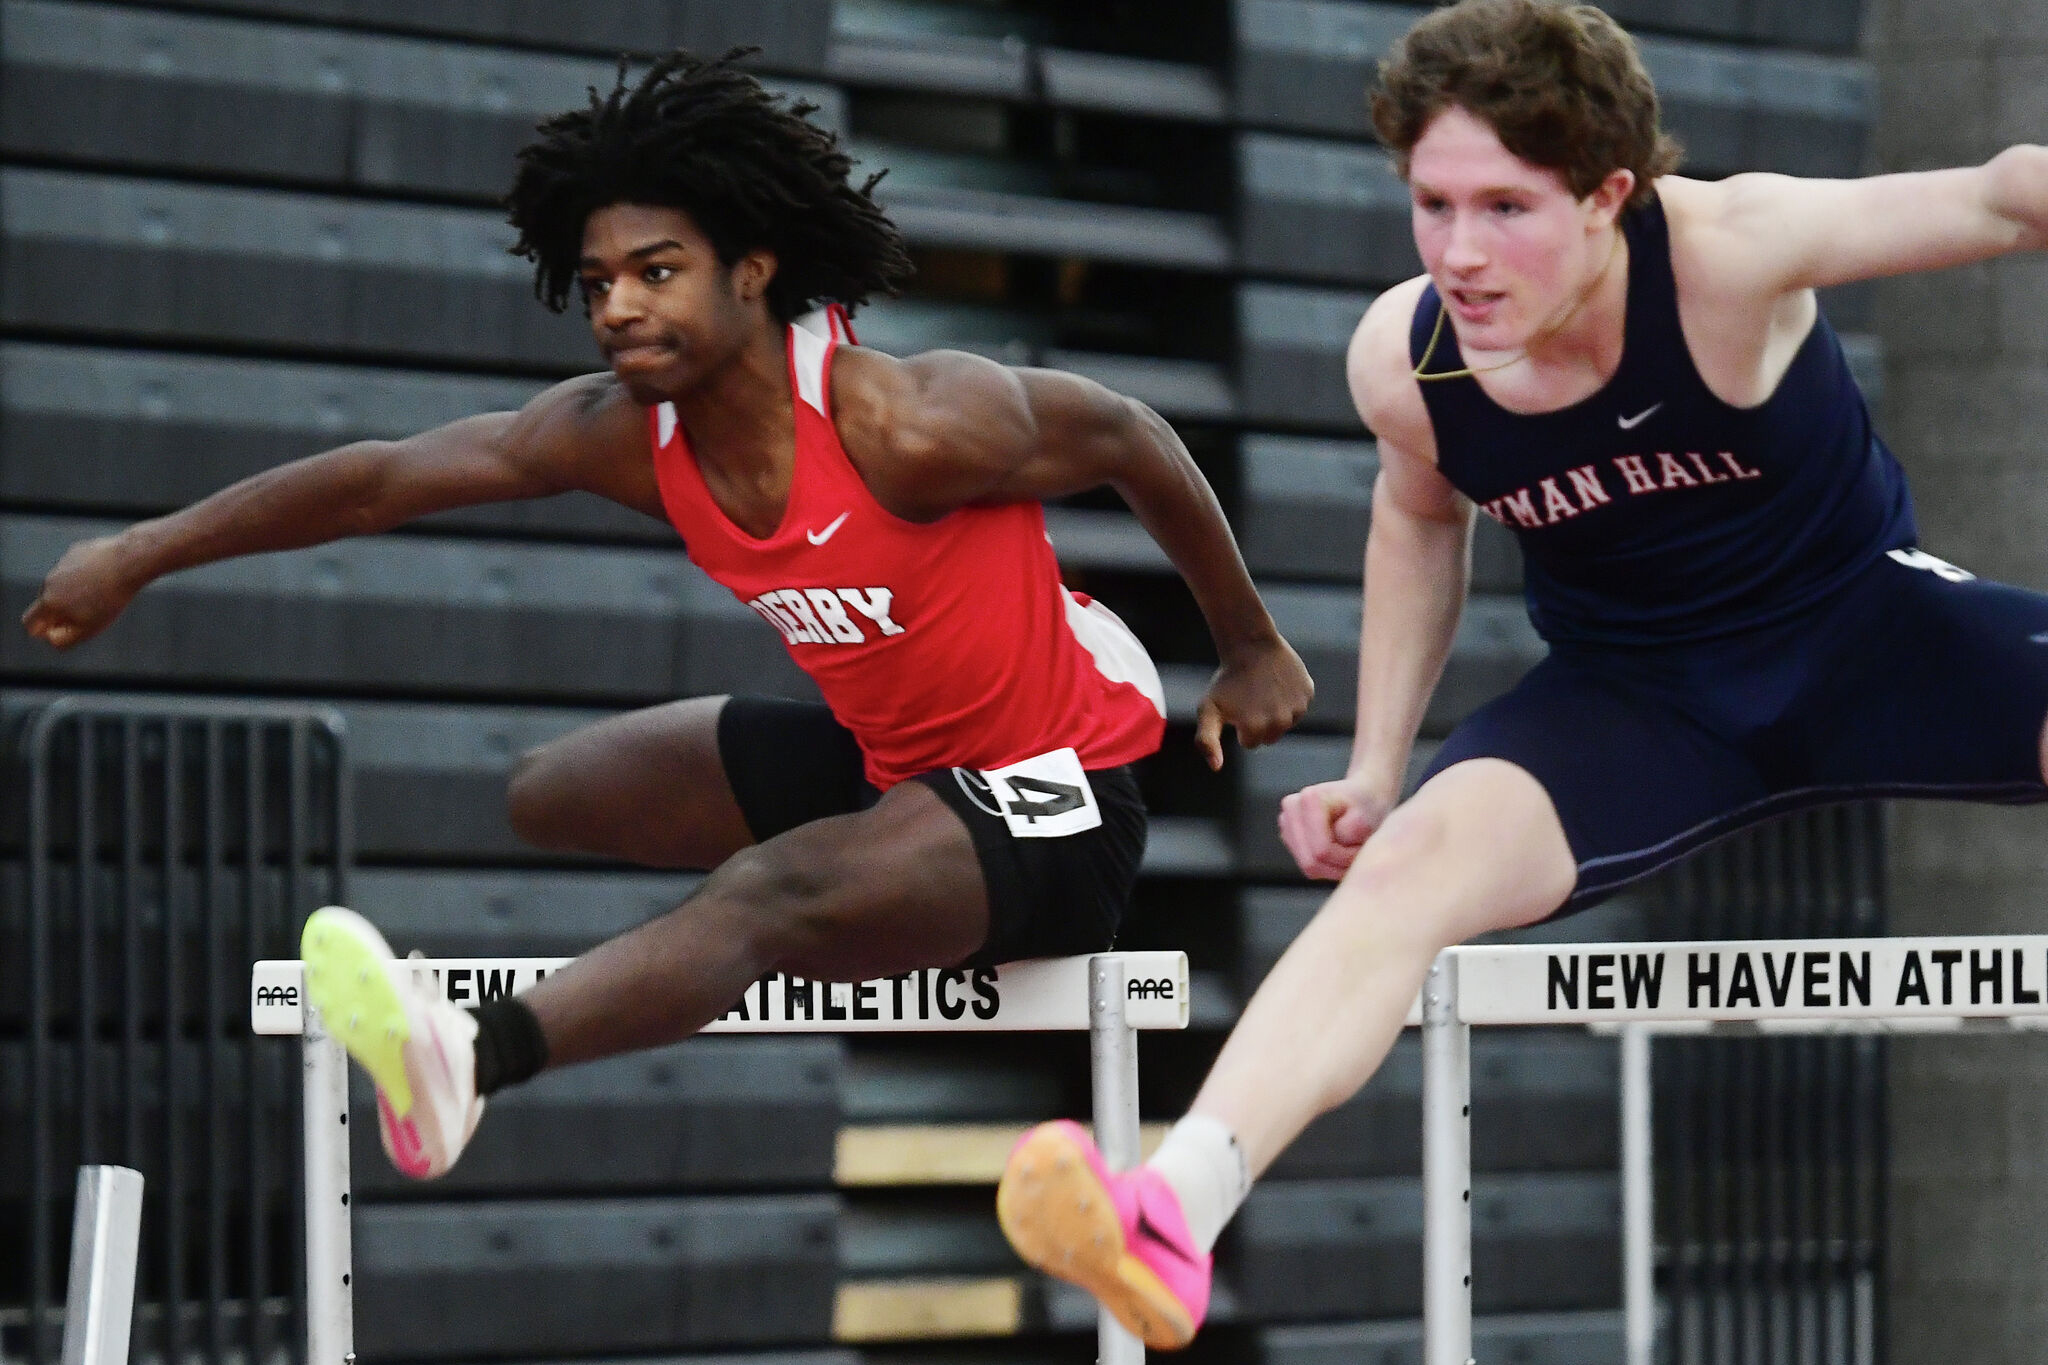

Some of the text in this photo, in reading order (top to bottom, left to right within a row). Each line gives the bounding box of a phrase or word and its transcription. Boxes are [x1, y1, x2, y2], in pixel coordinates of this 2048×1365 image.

[1611, 451, 1762, 495] HALL
[748, 586, 906, 646] DERBY
[1003, 774, 1087, 824] 4
[412, 969, 516, 1006] EW
[1547, 947, 2048, 1010] NEW HAVEN ATHL
